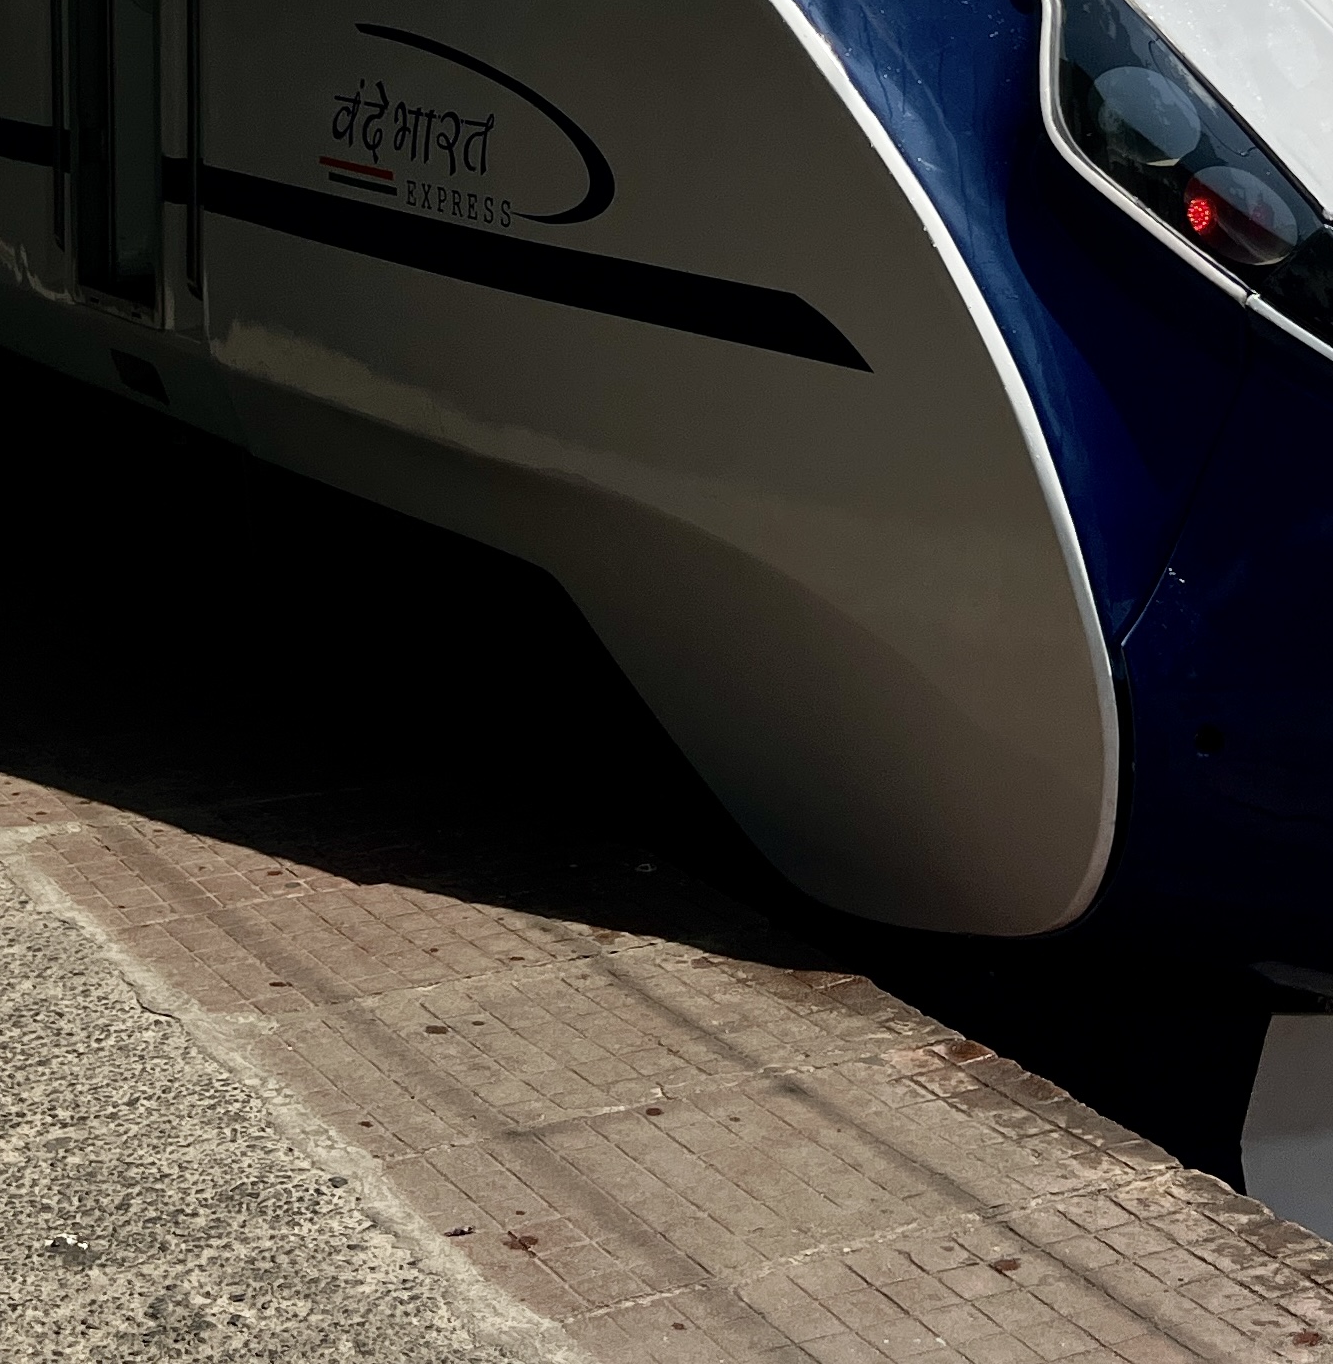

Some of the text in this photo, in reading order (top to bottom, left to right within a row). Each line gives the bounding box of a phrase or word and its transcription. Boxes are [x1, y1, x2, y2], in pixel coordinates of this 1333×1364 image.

[332, 78, 495, 176] वंदे भारत
[406, 180, 512, 228] EXPRESS
